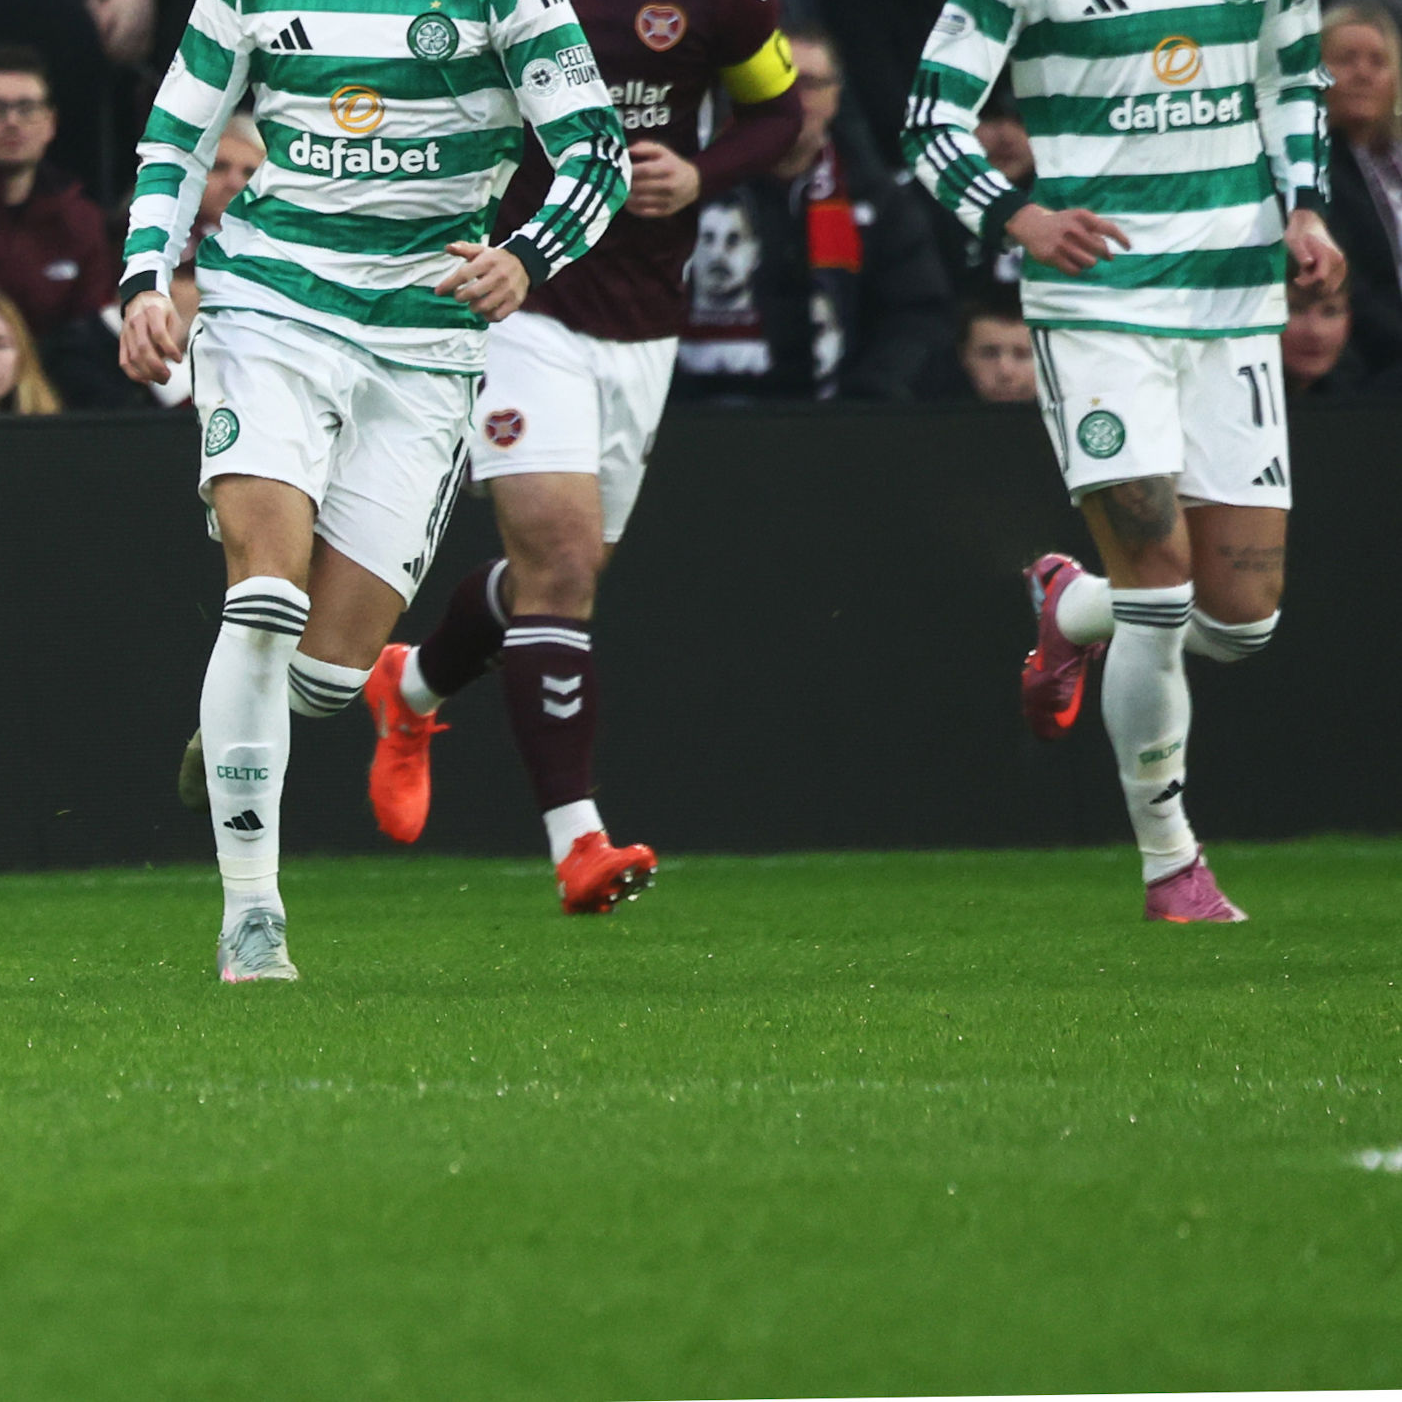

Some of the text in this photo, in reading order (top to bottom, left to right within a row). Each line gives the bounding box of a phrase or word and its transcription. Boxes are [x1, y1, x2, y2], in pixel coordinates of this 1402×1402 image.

[607, 81, 673, 105] ellar
[1108, 90, 1243, 134] dafabet
[289, 132, 440, 178] dafabet
[1237, 362, 1278, 428] 11
[216, 765, 269, 781] CELTIC
